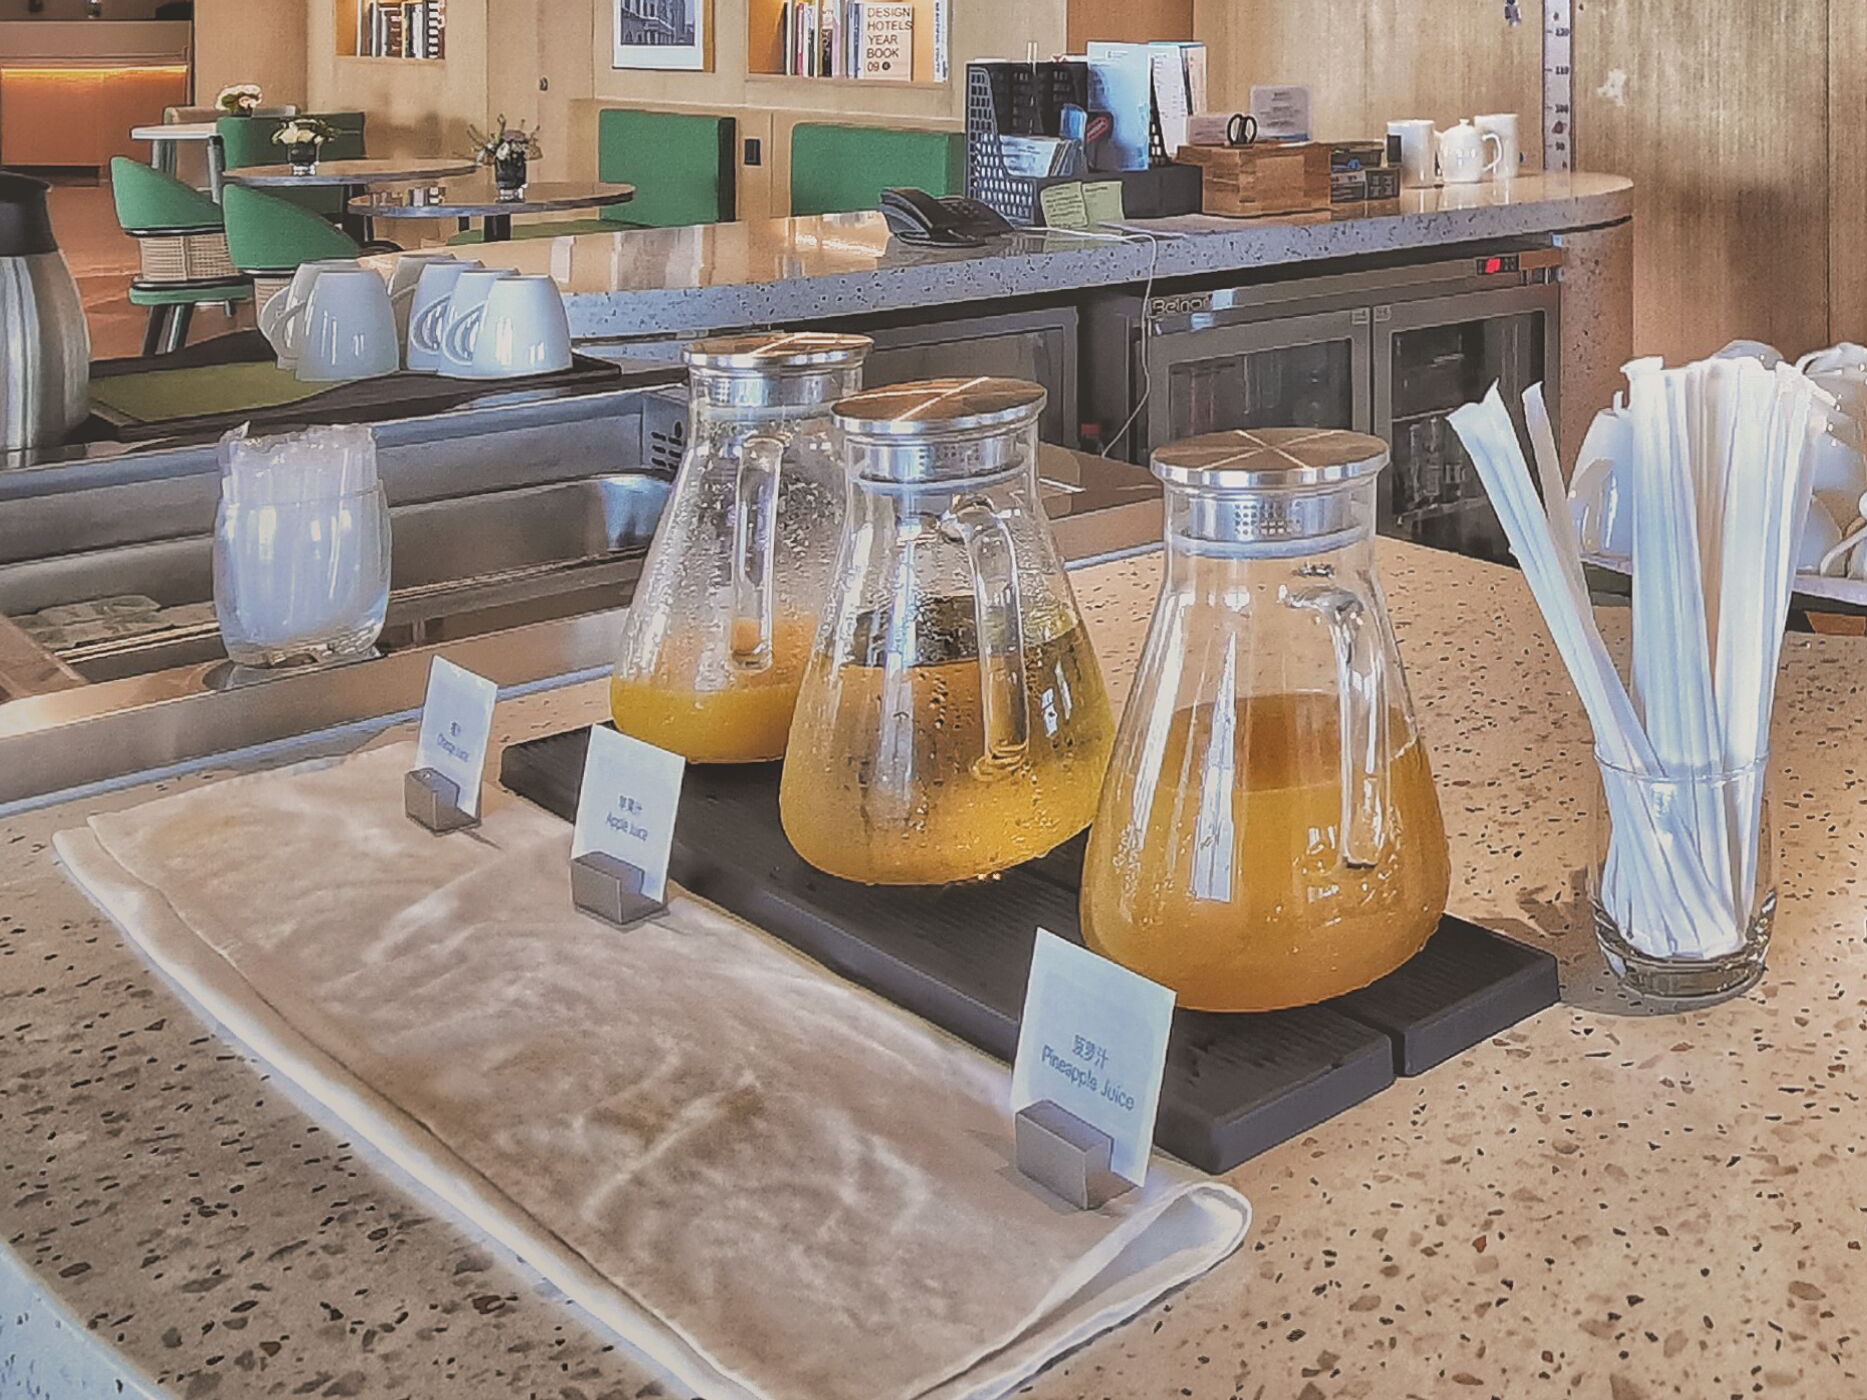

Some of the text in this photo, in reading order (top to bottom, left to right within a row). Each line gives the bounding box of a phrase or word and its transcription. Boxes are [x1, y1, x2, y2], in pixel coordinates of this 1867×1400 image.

[867, 7, 911, 18] DESIGN
[867, 20, 912, 31] HOTELS
[867, 35, 898, 45] YEAR
[867, 48, 900, 59] BOOK
[867, 61, 880, 72] 09
[605, 813, 648, 842] Apple Juice
[1041, 1044, 1135, 1112] Pineapple Juice
